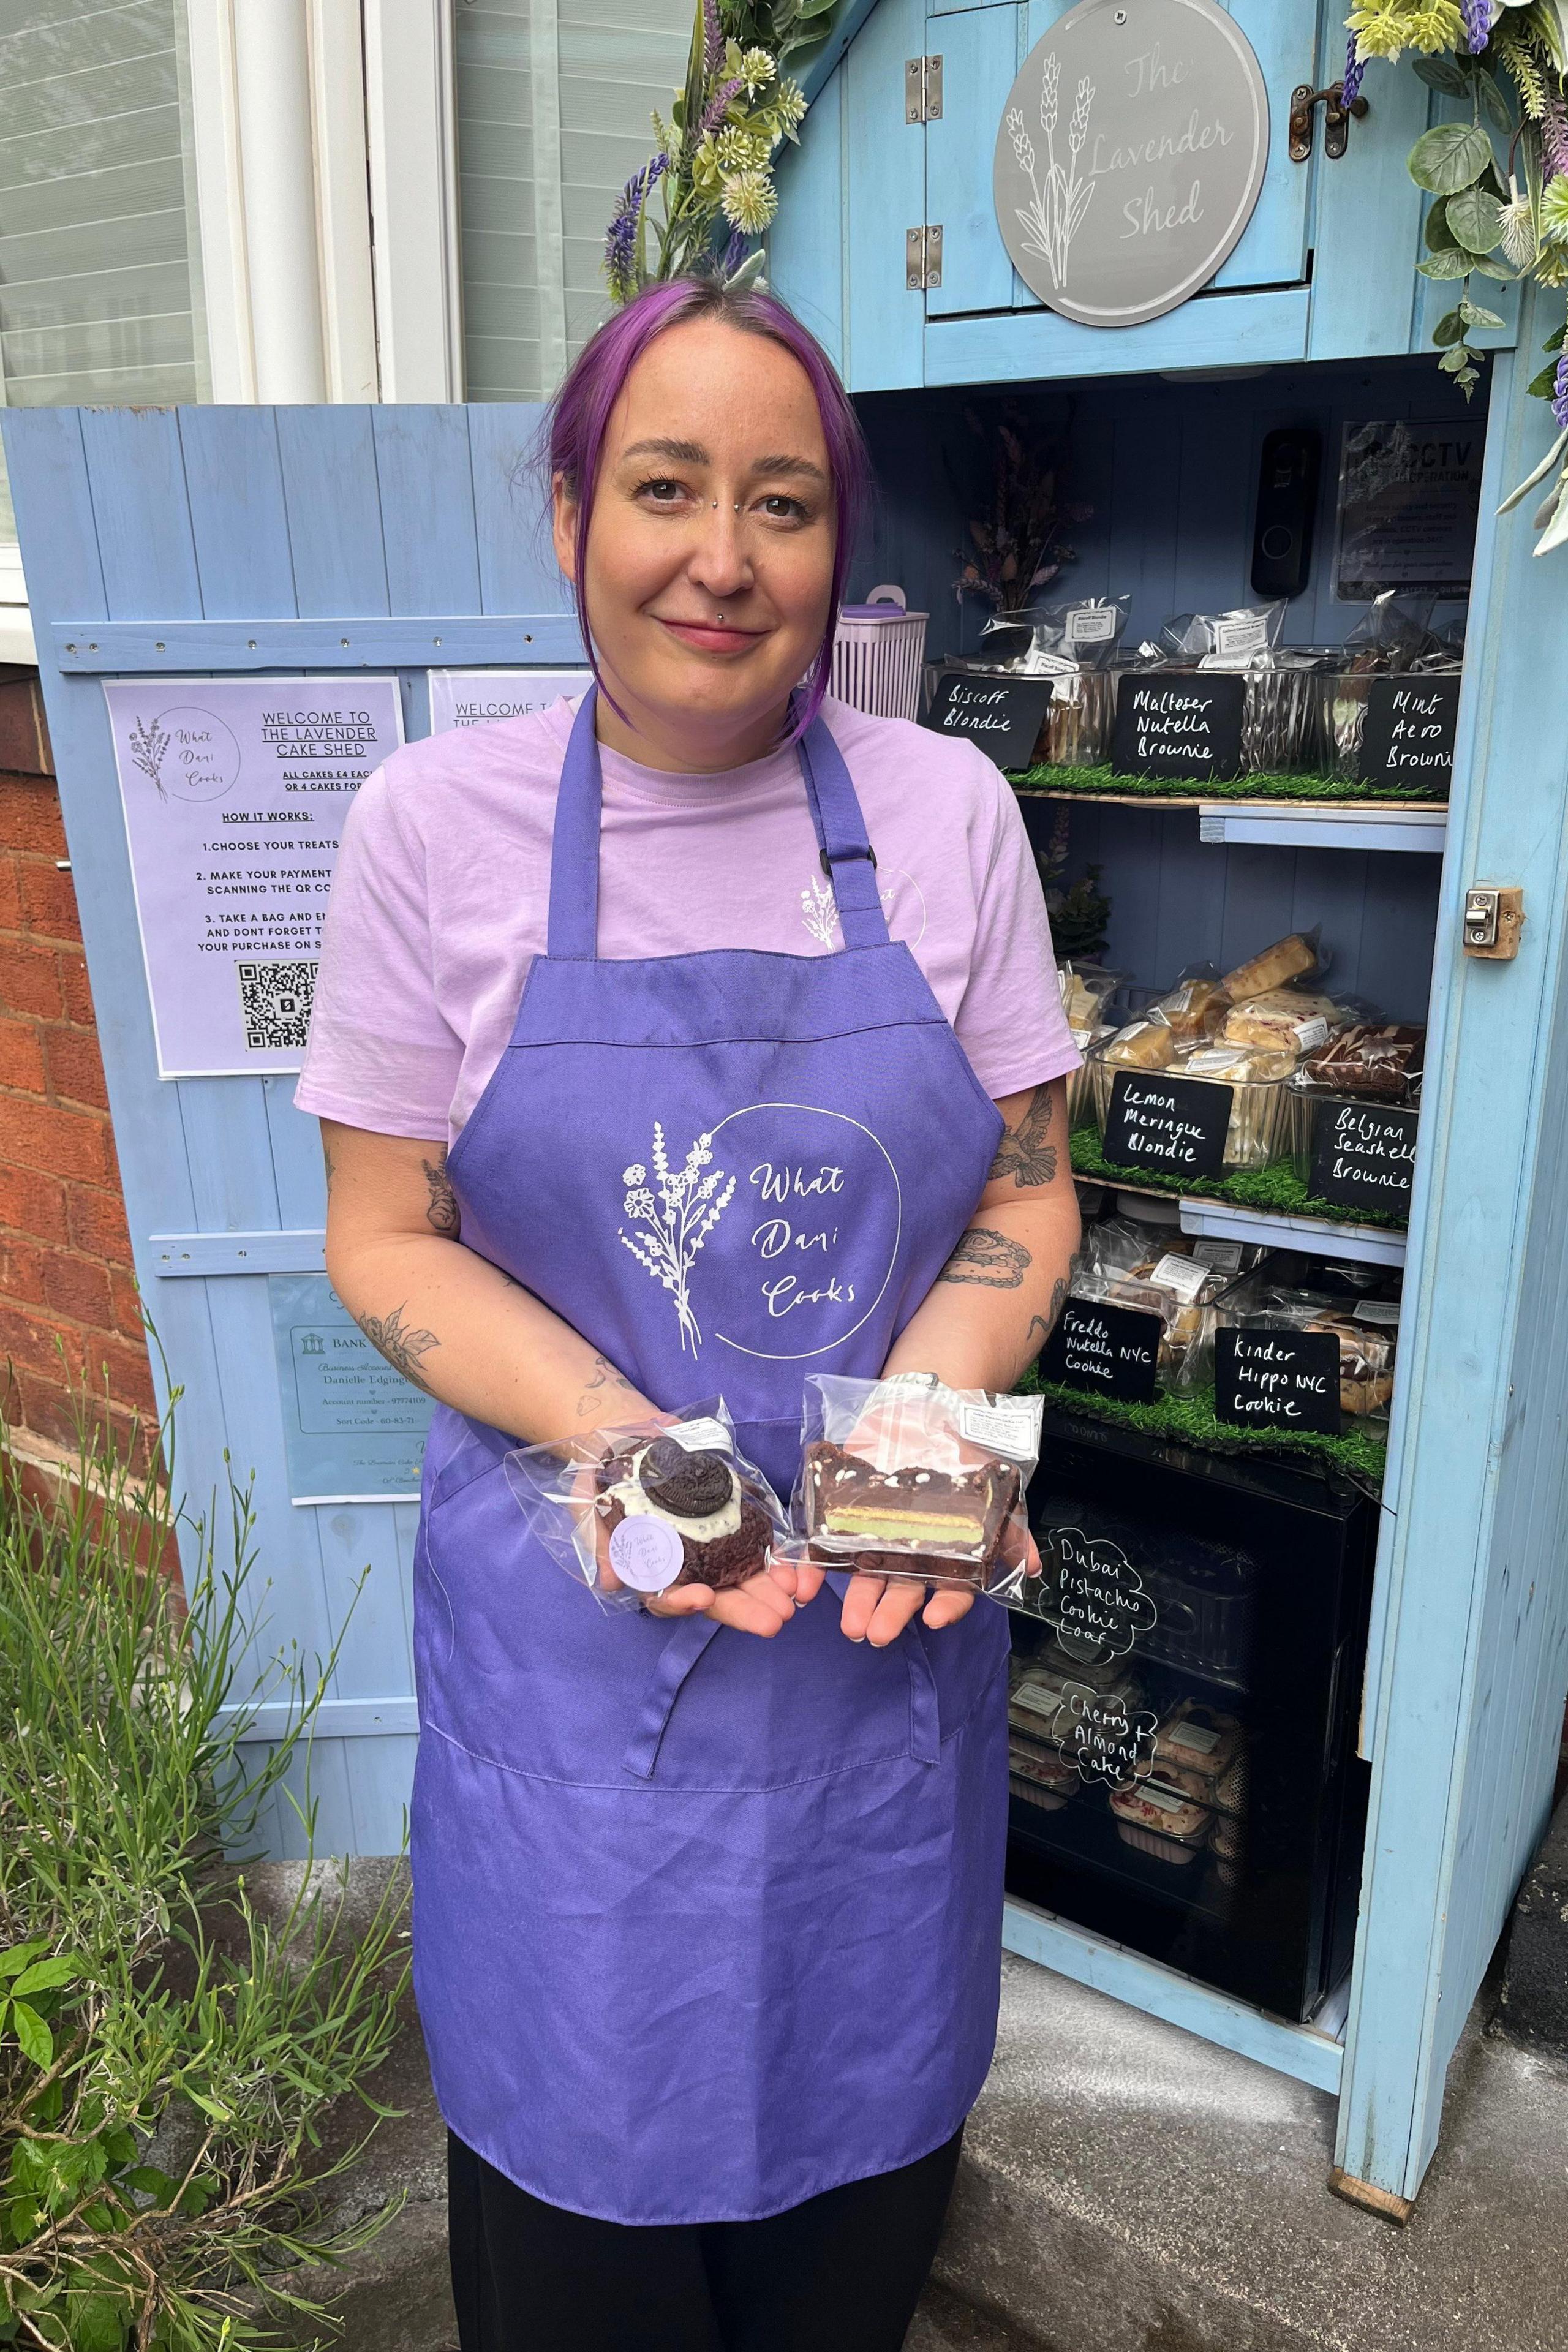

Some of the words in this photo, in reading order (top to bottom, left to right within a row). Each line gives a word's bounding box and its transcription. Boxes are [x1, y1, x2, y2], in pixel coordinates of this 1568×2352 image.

[1125, 42, 1191, 98] The
[1088, 108, 1234, 176] Lavender
[1119, 180, 1204, 239] Shed
[1405, 442, 1471, 467] CCTV
[949, 684, 1009, 705] Biscoff
[1133, 690, 1213, 715] Malteser
[1392, 690, 1444, 715] Mint
[263, 711, 343, 725] WELCOME
[349, 711, 370, 724] TO
[456, 703, 533, 715] WELCOME
[943, 707, 1012, 731] Blondie
[175, 729, 213, 744] What
[261, 728, 288, 741] THE
[295, 727, 375, 741] LAVENDER
[1137, 714, 1210, 734] Nutella
[1391, 720, 1442, 740] Aero
[277, 744, 317, 756] CAKE
[324, 743, 364, 756] SHED
[1137, 737, 1214, 760] Brownie
[1386, 745, 1453, 768] Browni
[186, 771, 224, 787] Cooks
[222, 813, 250, 821] HOW
[254, 812, 263, 821] IT
[267, 812, 313, 821] WORKS:
[203, 841, 260, 851] 1.CHOOSE
[263, 840, 295, 850] YOUR
[298, 840, 339, 850] TREATS
[211, 871, 243, 880] MAKE
[246, 870, 277, 879] YOUR
[281, 870, 332, 878] PAYMENT
[207, 885, 267, 894] SCANNING
[271, 884, 292, 893] THE
[315, 884, 331, 892] CO
[262, 913, 285, 922] BAG
[289, 913, 312, 921] AND
[234, 928, 264, 937] DONT
[268, 927, 312, 936] FORGET
[198, 943, 228, 952] YOUR
[232, 941, 291, 951] PURCHASE
[1123, 1084, 1175, 1112] Lemon
[1124, 1108, 1207, 1140] Meringue
[1335, 1107, 1404, 1142] Belgian
[1128, 1133, 1197, 1163] Blondie
[1334, 1134, 1417, 1164] Seashell
[750, 1163, 845, 1202] What
[1332, 1158, 1411, 1189] Brownie
[752, 1219, 839, 1259] Dani
[761, 1275, 855, 1317] Cooks
[1063, 1310, 1109, 1339] Freddo
[333, 1338, 368, 1348] BANK
[1066, 1336, 1113, 1358] Nutella
[1120, 1347, 1152, 1363] NYC
[1234, 1335, 1295, 1362] Kinder
[318, 1363, 355, 1371] Business
[1065, 1354, 1114, 1379] Cookie
[323, 1376, 366, 1384] Danielle
[1238, 1365, 1288, 1392] Hippo
[1296, 1373, 1326, 1394] NYC
[1234, 1396, 1302, 1417] Cookie
[1061, 1538, 1121, 1579] Dubai
[1060, 1594, 1118, 1630] Cookie
[1070, 1695, 1128, 1735] Cherry
[1074, 1724, 1137, 1761] Almond
[1078, 1747, 1125, 1781] Cake
